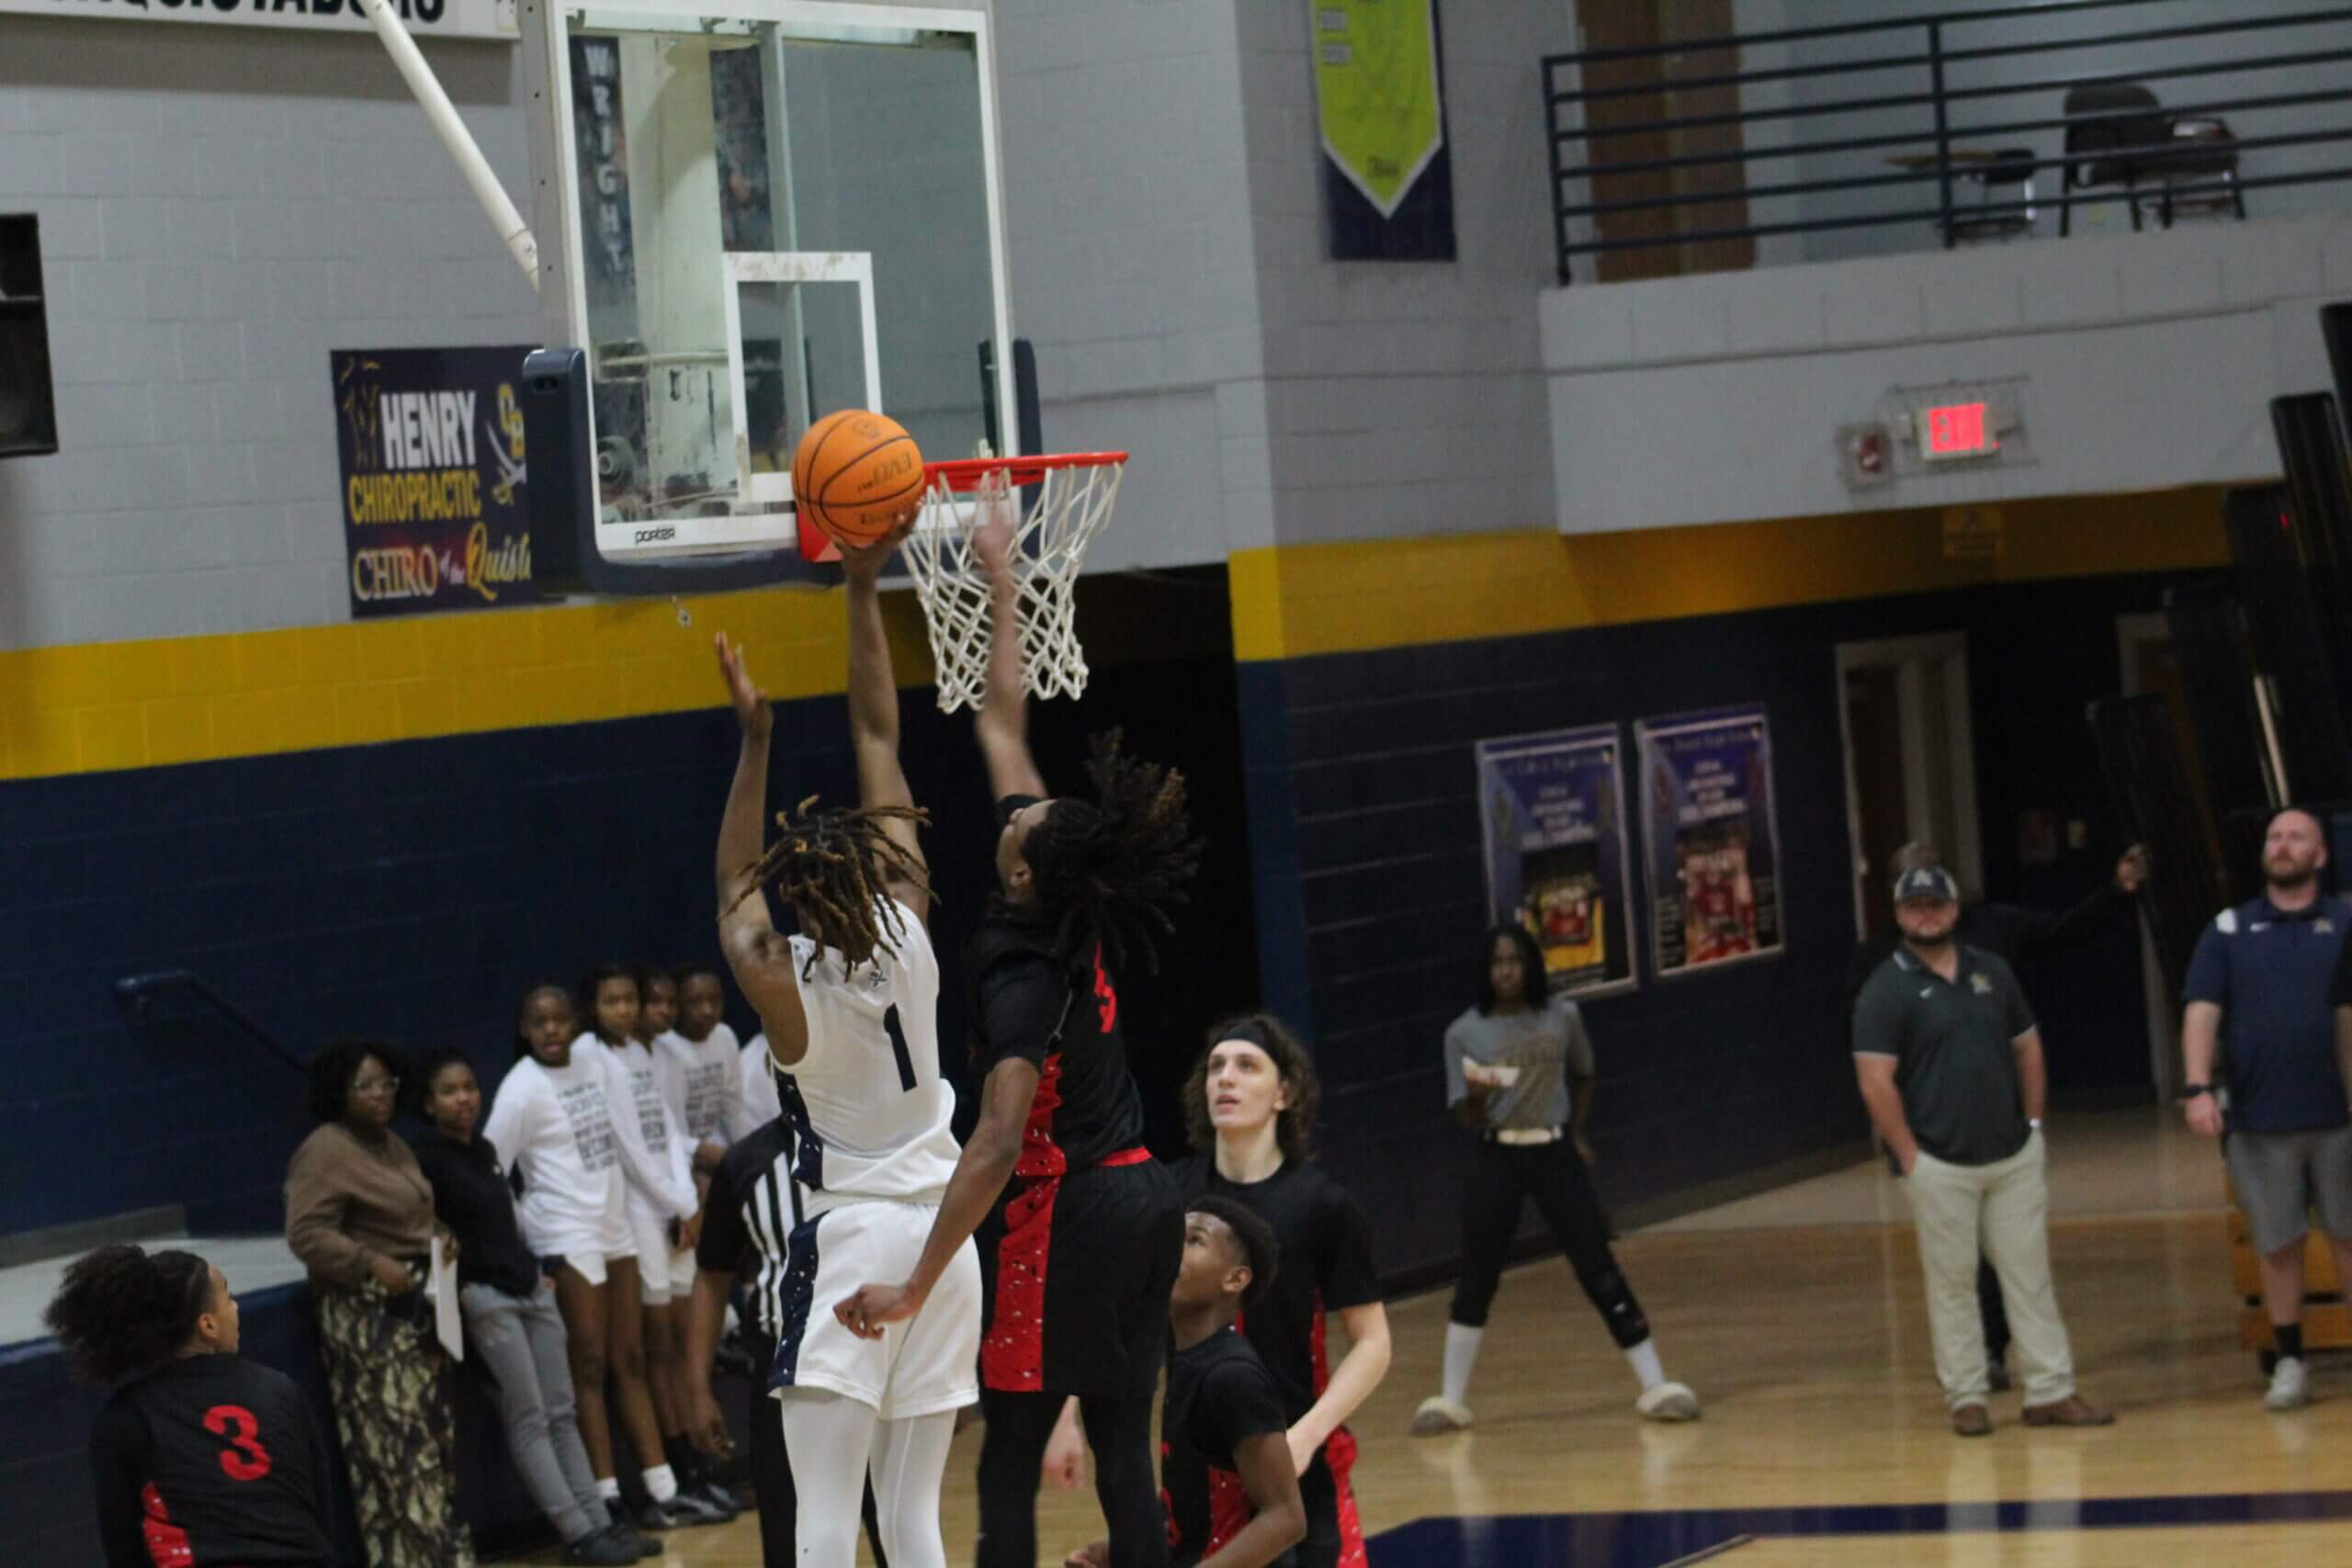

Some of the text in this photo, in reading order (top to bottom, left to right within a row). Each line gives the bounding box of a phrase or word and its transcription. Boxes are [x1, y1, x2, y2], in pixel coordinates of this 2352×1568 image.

[380, 391, 476, 469] HENRY
[1928, 402, 1984, 453] EXIT
[348, 469, 482, 525] CHIROPRACTIC
[353, 545, 438, 601] CHIRO
[883, 1002, 918, 1093] 1
[203, 1404, 273, 1482] 3
